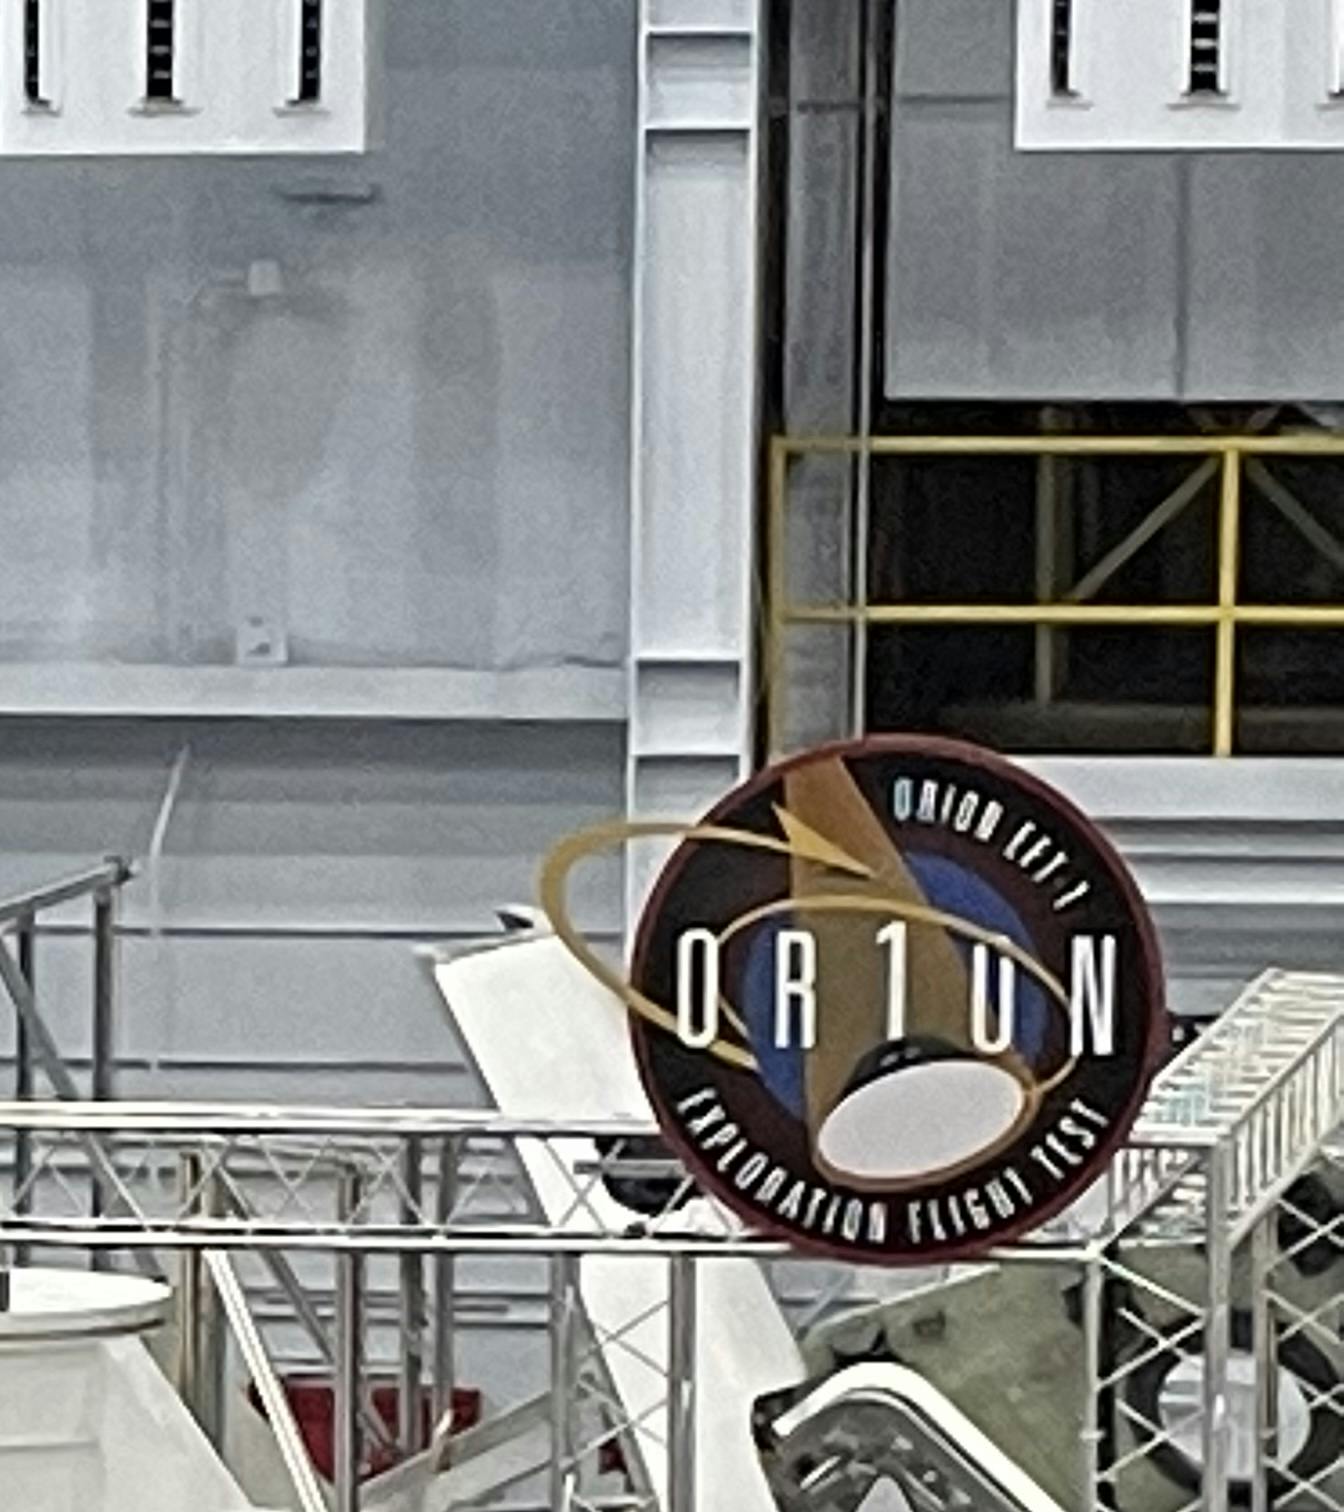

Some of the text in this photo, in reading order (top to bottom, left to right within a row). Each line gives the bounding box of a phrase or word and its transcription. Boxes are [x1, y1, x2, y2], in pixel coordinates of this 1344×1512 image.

[893, 776, 1004, 842] ORION
[677, 1087, 1109, 1244] EXPLORATION FLIGHT TEST
